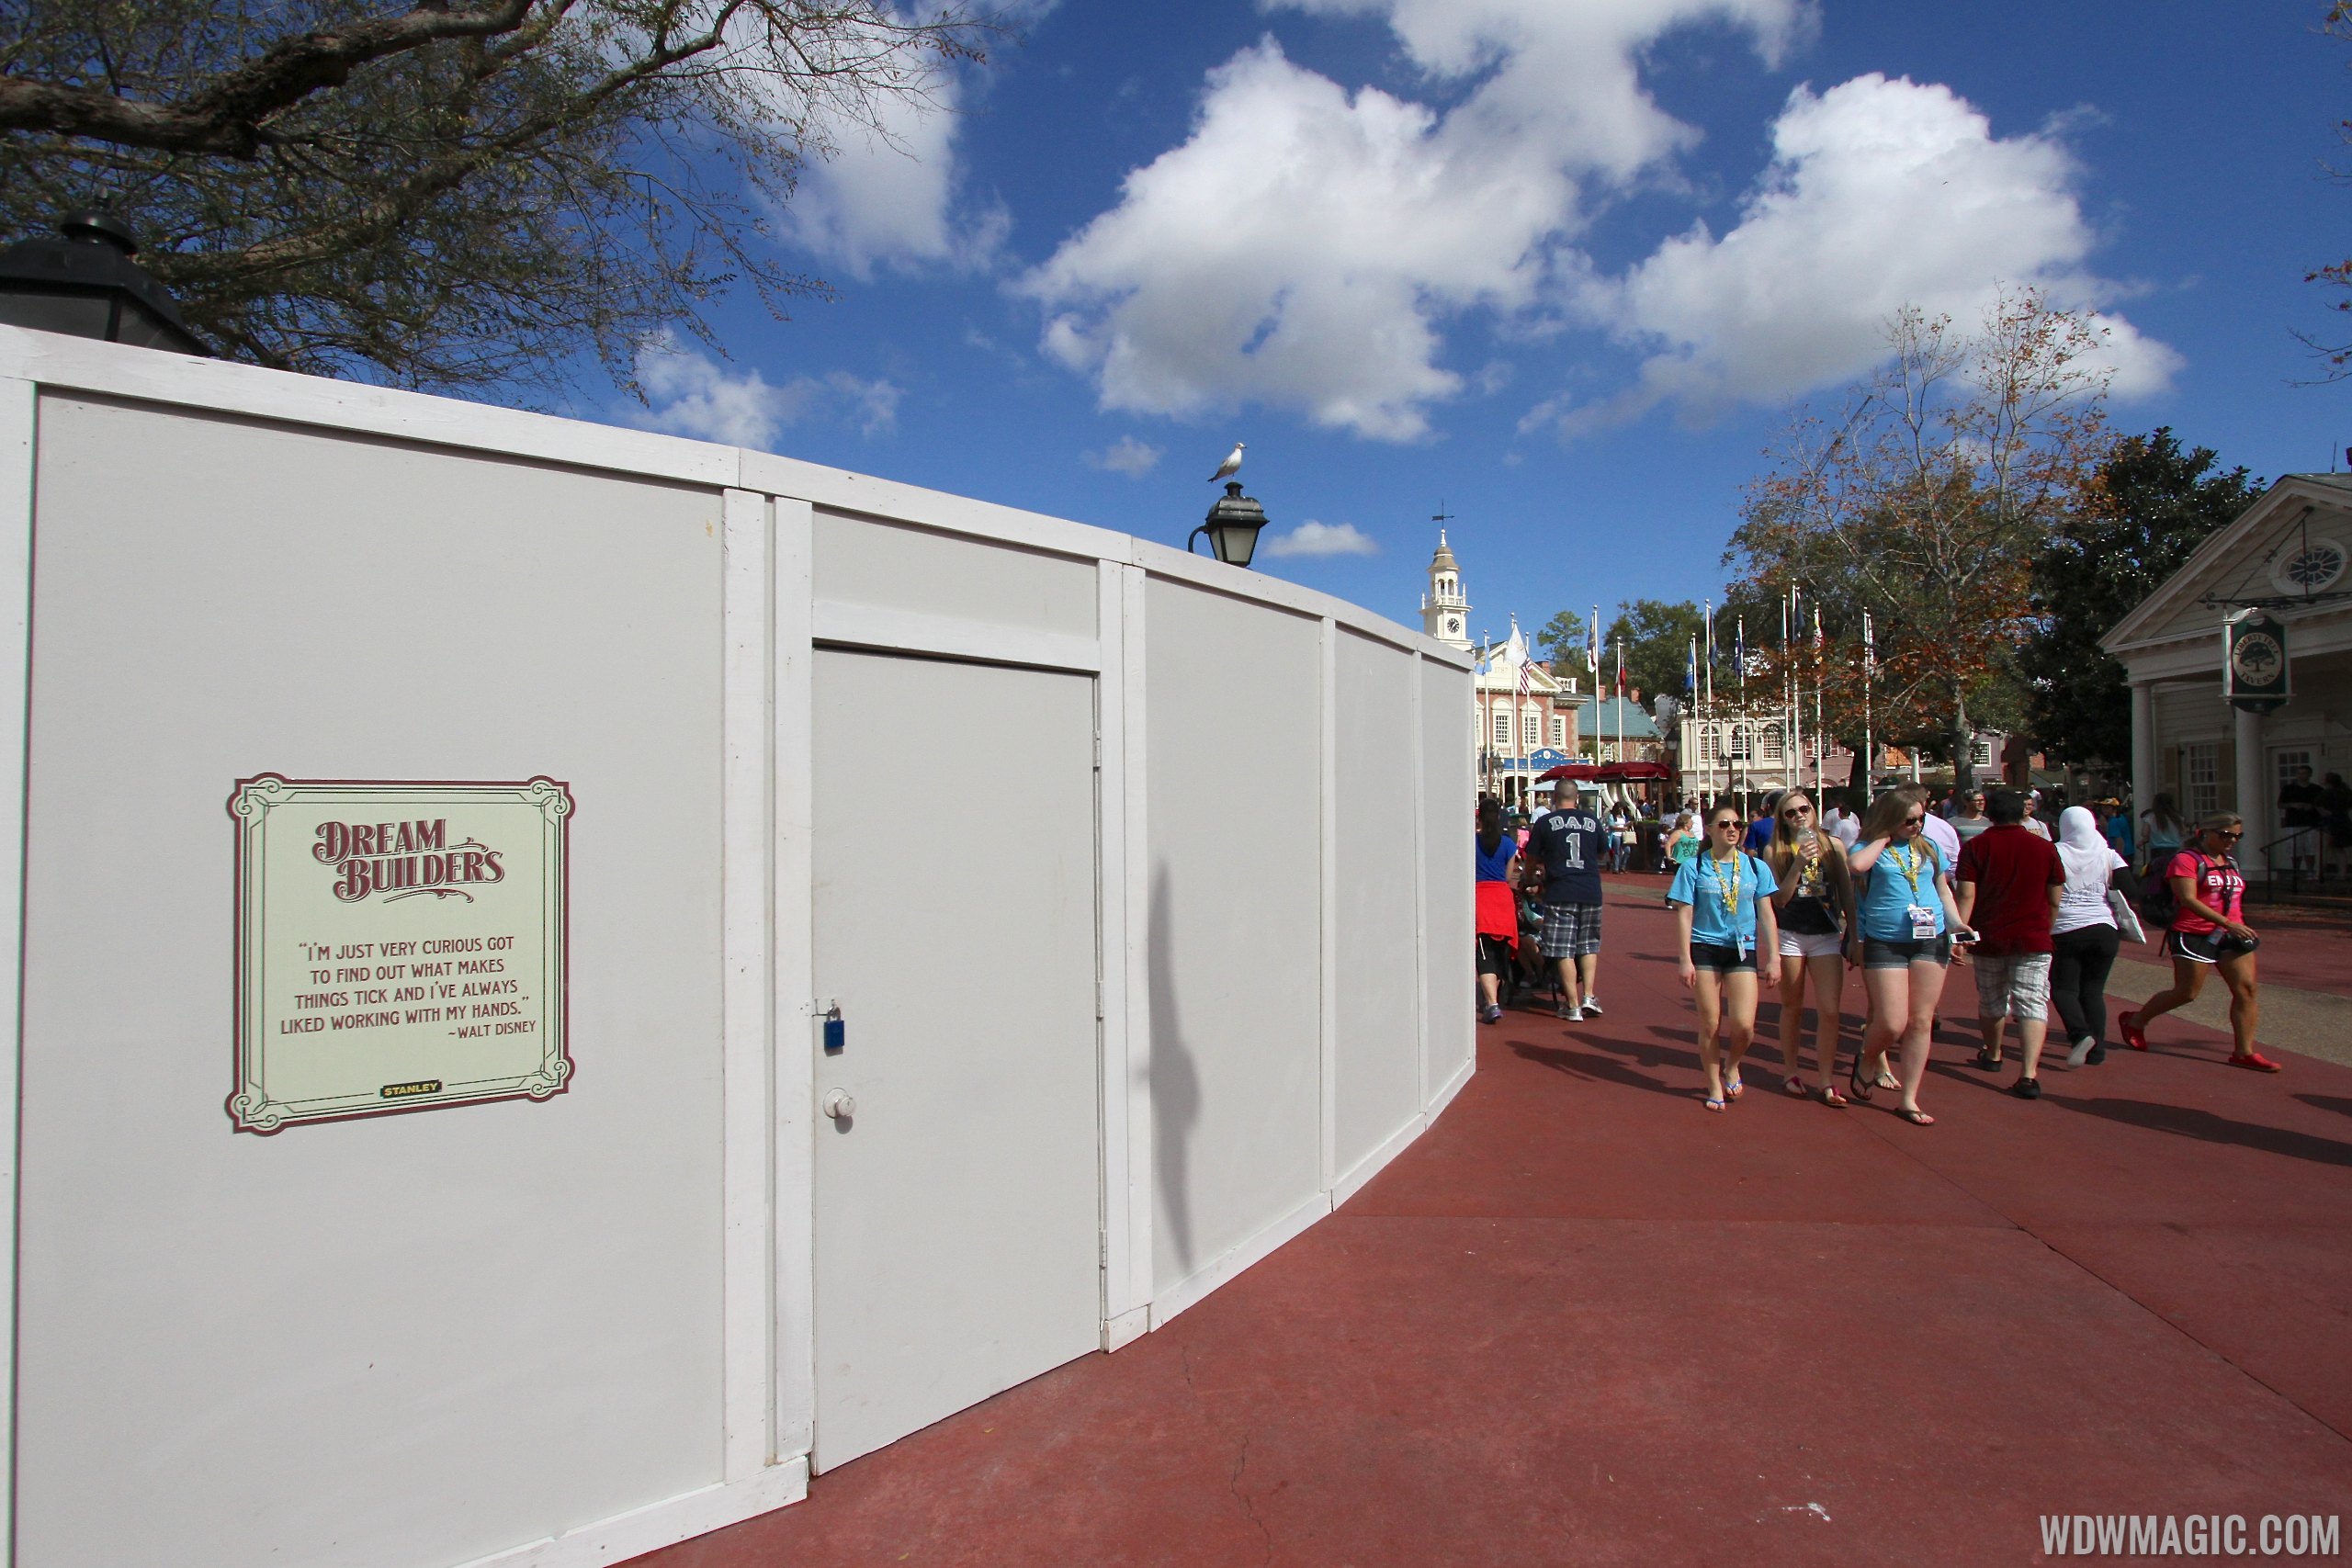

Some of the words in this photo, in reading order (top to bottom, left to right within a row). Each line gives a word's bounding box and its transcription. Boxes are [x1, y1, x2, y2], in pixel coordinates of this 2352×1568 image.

[2233, 634, 2262, 656] LIBERTY
[2241, 671, 2275, 685] TAVERN
[1548, 816, 1597, 832] DAD
[312, 818, 447, 865] DREAM
[1566, 832, 1585, 869] 1
[1680, 840, 1699, 850] WHA
[333, 851, 505, 903] BUILDERS
[336, 943, 375, 960] JUST
[379, 941, 417, 957] VERY
[423, 937, 483, 955] CURIOUS
[487, 936, 514, 951] GOT
[310, 969, 331, 986] TO
[336, 967, 370, 984] FIND
[376, 964, 406, 981] OUT
[411, 962, 453, 978] WHAT
[458, 958, 504, 976] MAKES
[294, 991, 349, 1010] THINGS
[354, 988, 388, 1006] TICK
[393, 986, 425, 1002] AND
[430, 980, 457, 999] I'VE
[461, 979, 518, 998] ALWAYS
[280, 1017, 325, 1035] LIKED
[331, 1010, 401, 1031] WORKING
[405, 1008, 441, 1024] WITH
[446, 1005, 467, 1021] MY
[495, 1020, 537, 1036] DISNEY
[384, 1082, 438, 1097] STANLEY
